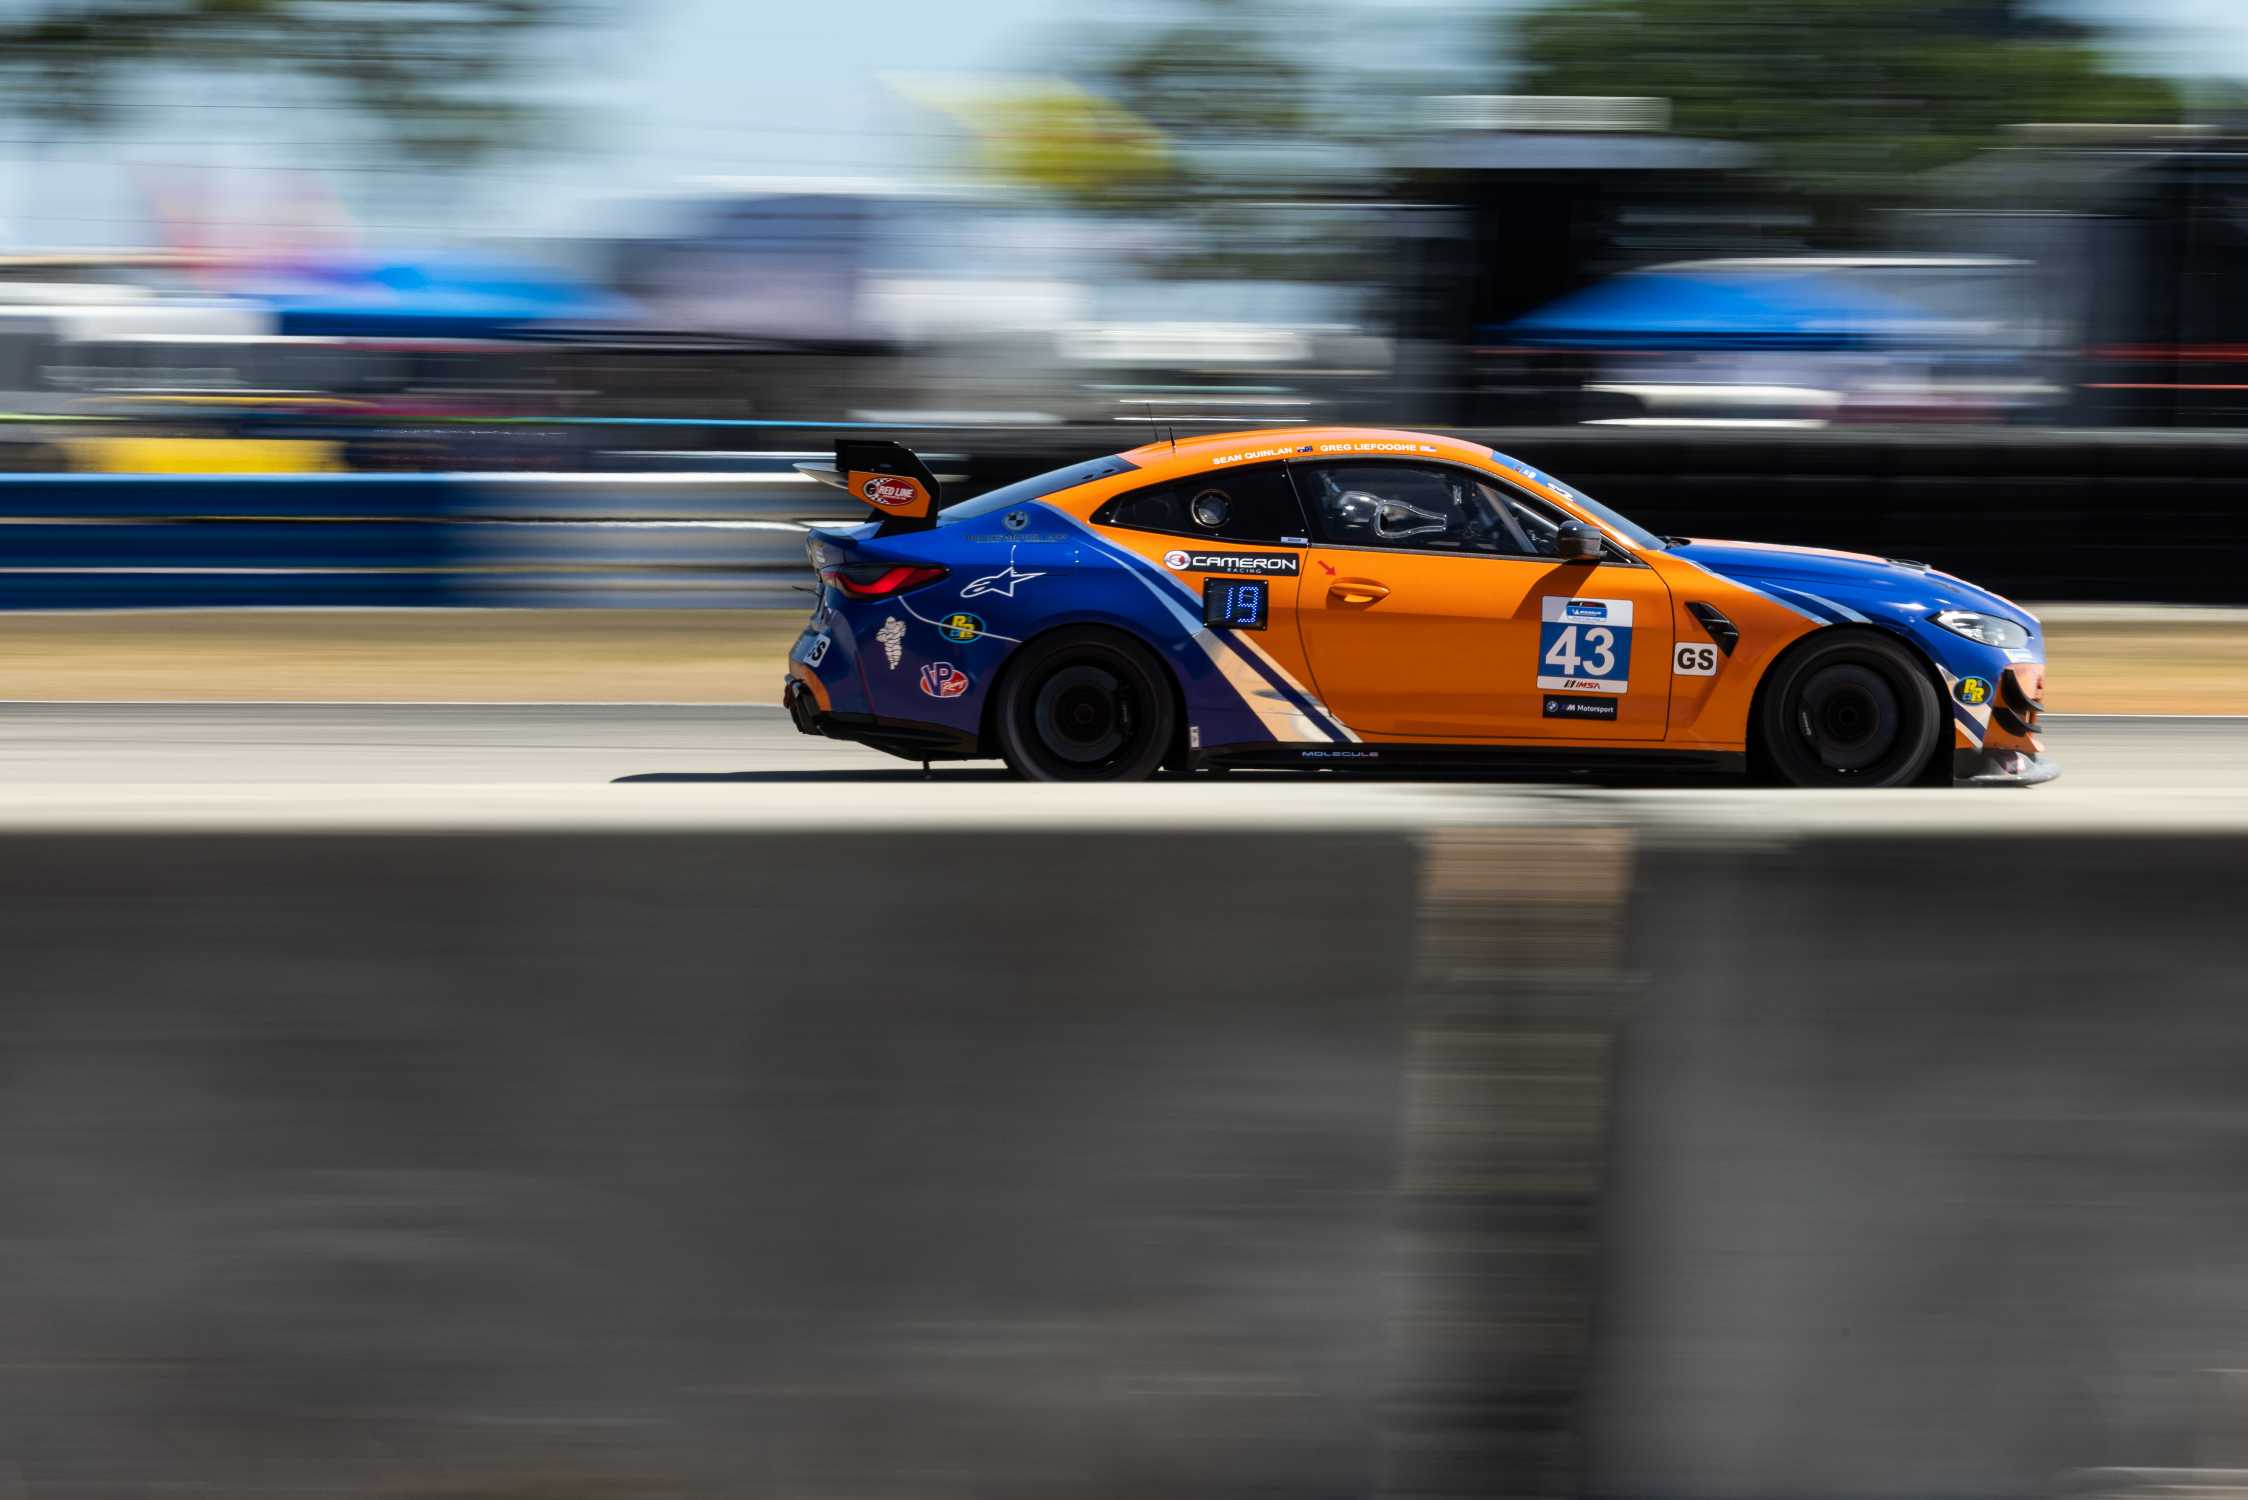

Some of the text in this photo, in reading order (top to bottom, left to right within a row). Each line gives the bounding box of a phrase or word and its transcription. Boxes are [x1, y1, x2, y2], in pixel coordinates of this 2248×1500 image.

[1320, 443, 1417, 452] GREG LIEFOOGHE
[1212, 447, 1293, 465] SEAN QUINLAN
[880, 486, 896, 496] RED
[1192, 556, 1297, 570] CAMERON
[1225, 586, 1259, 623] 19
[1545, 625, 1616, 676] 43
[1677, 648, 1715, 670] GS
[1577, 705, 1614, 713] Motorsport
